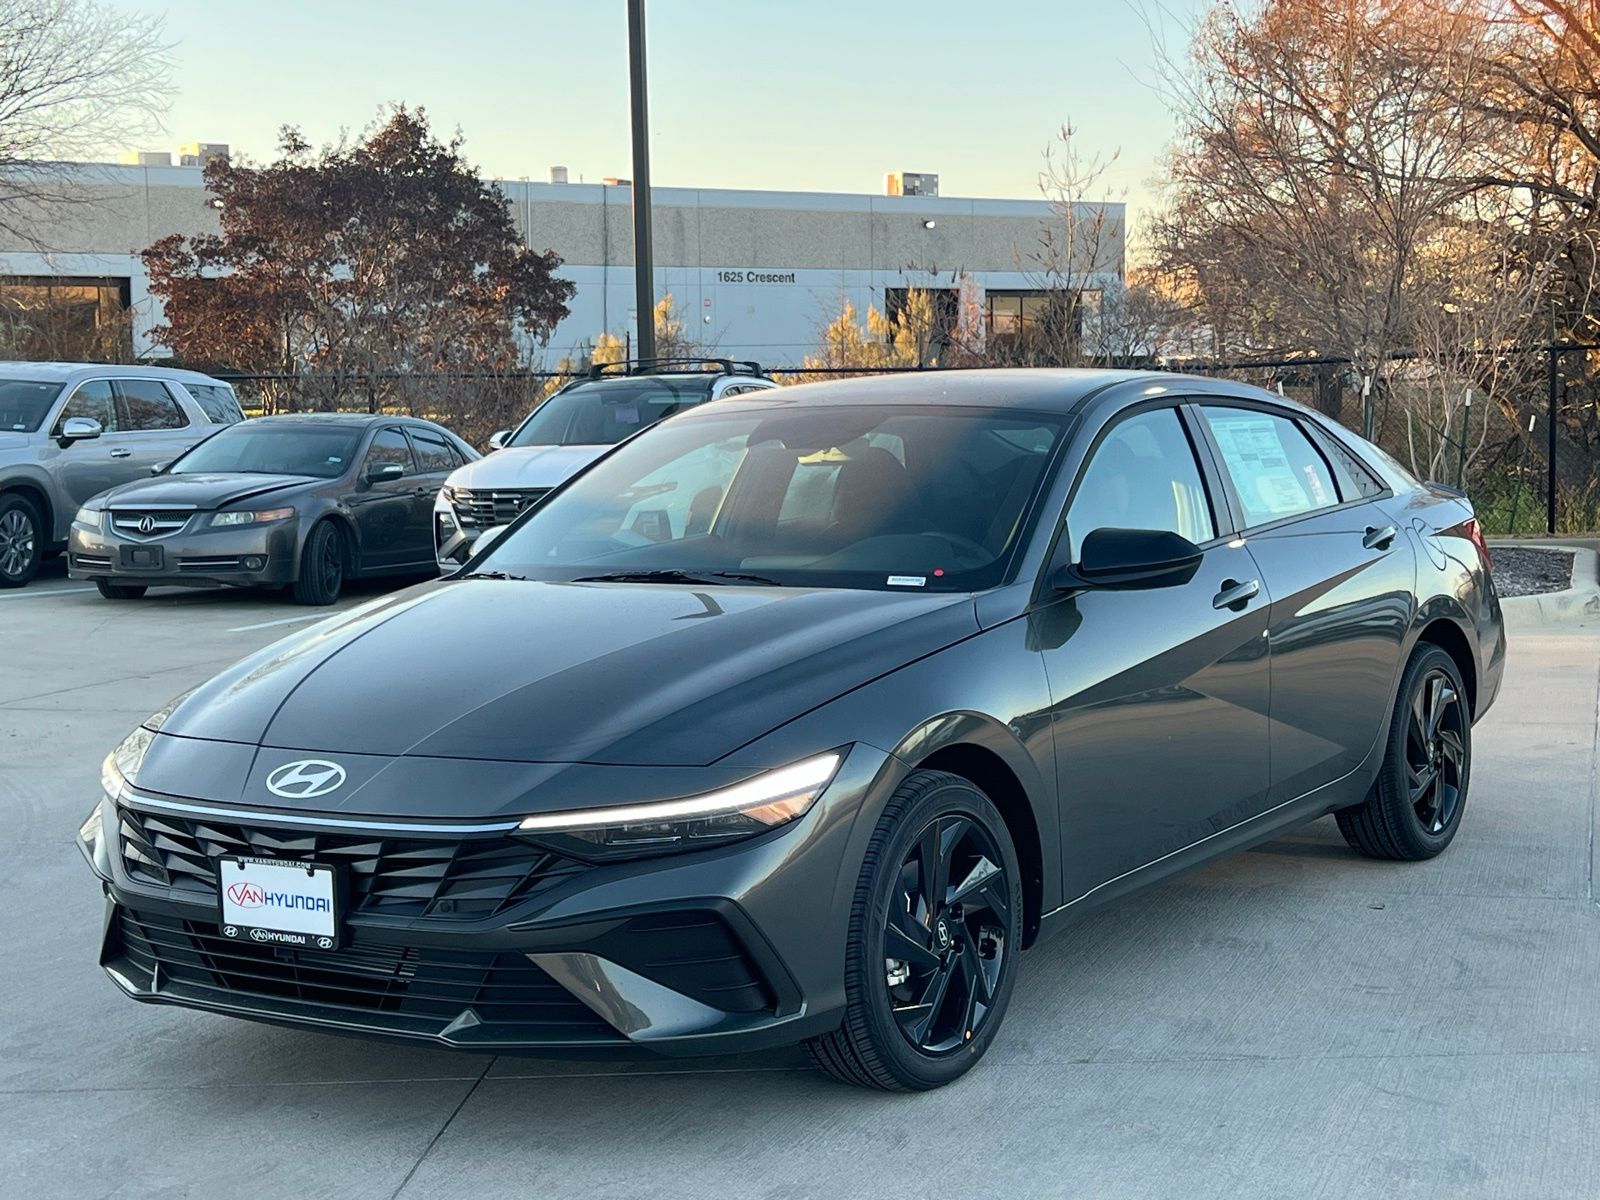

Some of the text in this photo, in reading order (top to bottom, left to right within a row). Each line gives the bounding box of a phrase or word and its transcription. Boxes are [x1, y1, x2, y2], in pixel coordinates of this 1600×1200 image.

[718, 271, 795, 283] 1625 Crescent
[230, 883, 330, 913] VAN HYUNDAI
[268, 933, 305, 944] HYUNDAI
